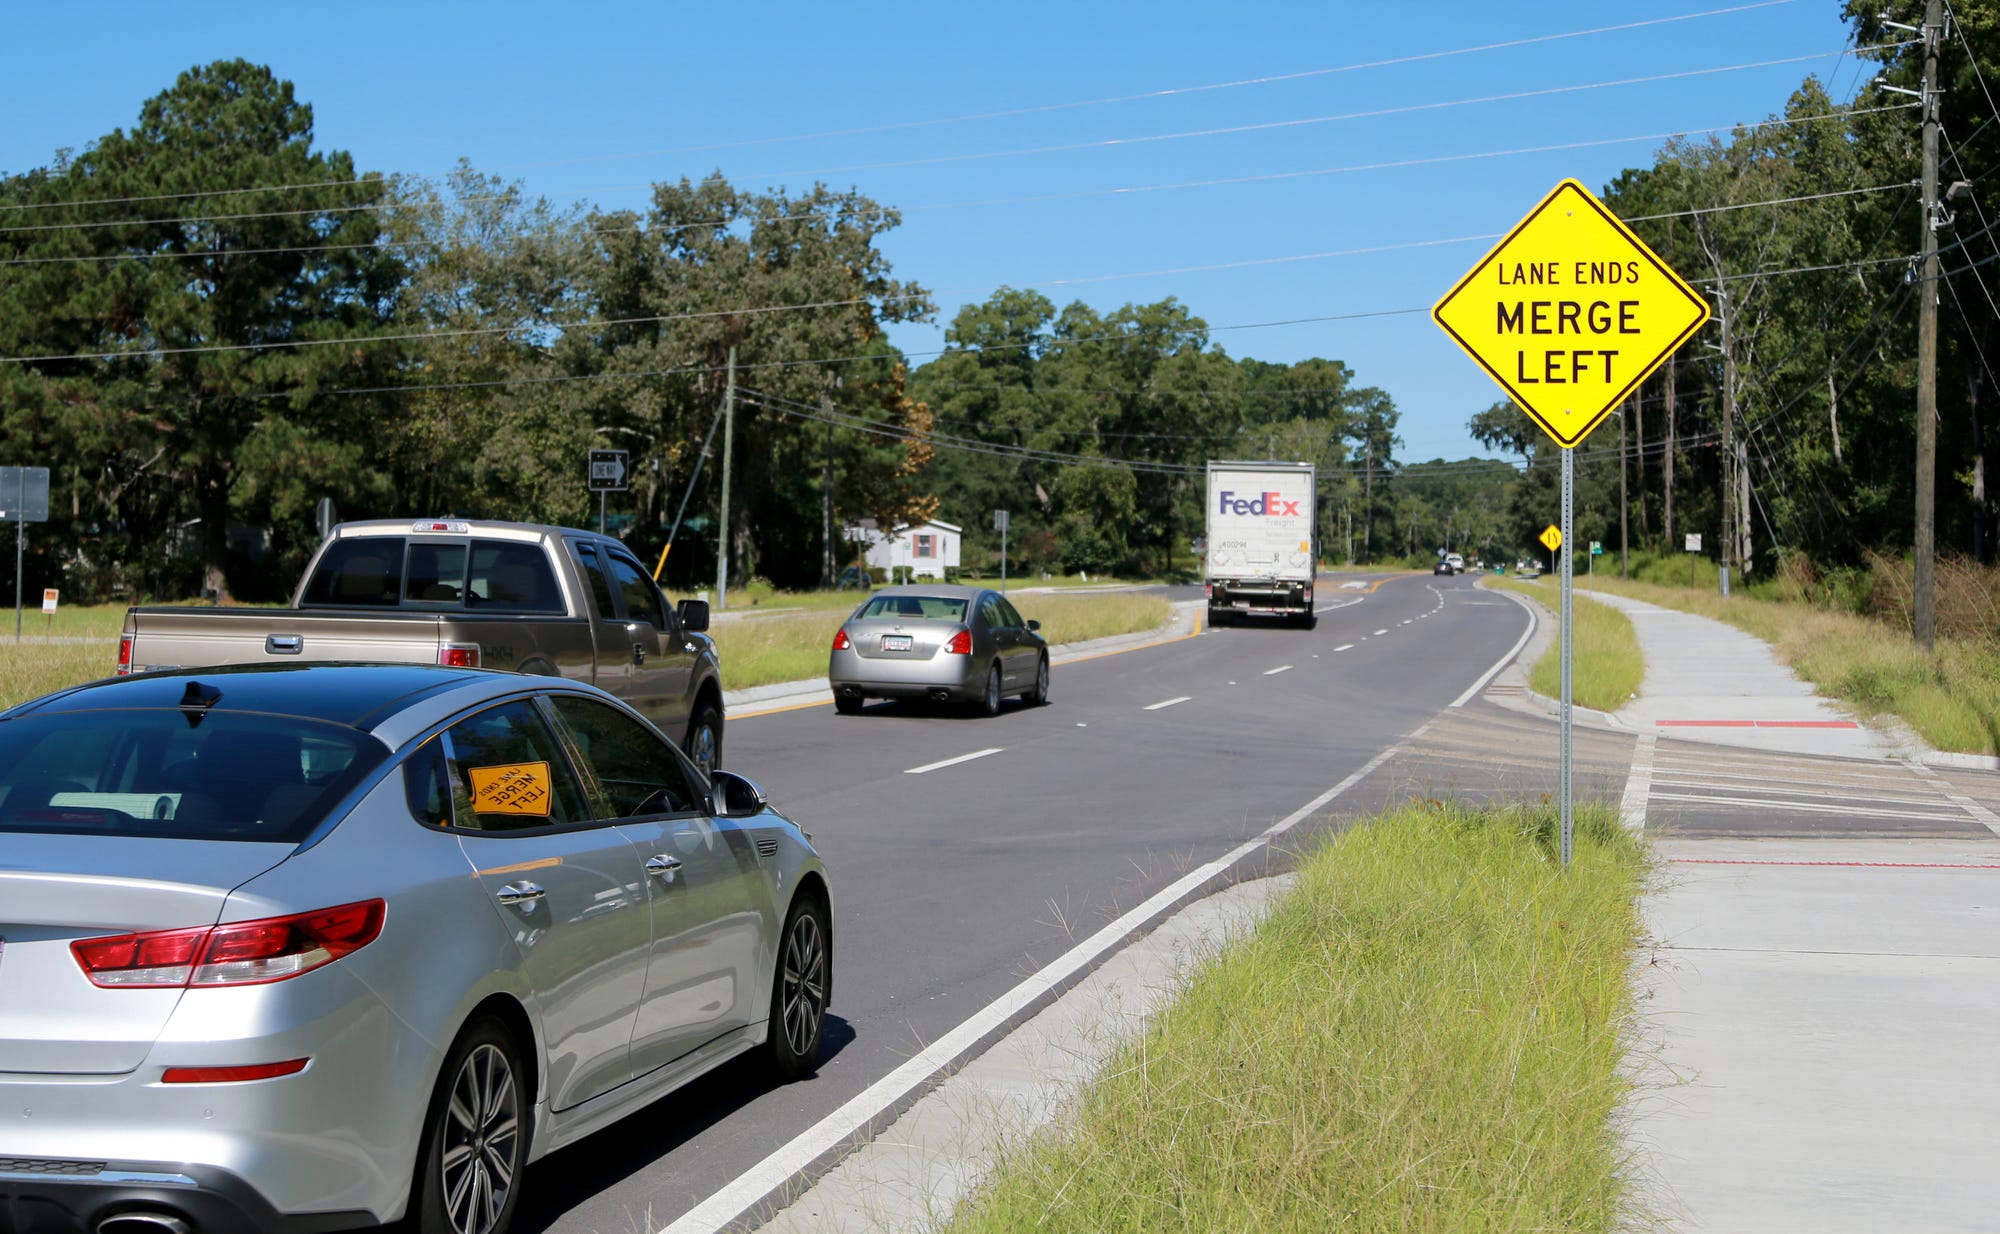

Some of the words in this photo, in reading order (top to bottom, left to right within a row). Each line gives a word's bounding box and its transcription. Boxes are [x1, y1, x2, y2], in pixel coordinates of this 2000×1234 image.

[1499, 262, 1560, 285] LANE
[1575, 261, 1639, 284] ENDS
[1496, 300, 1641, 335] MERGE
[1517, 350, 1619, 384] LEFT
[1220, 491, 1300, 516] FedEx
